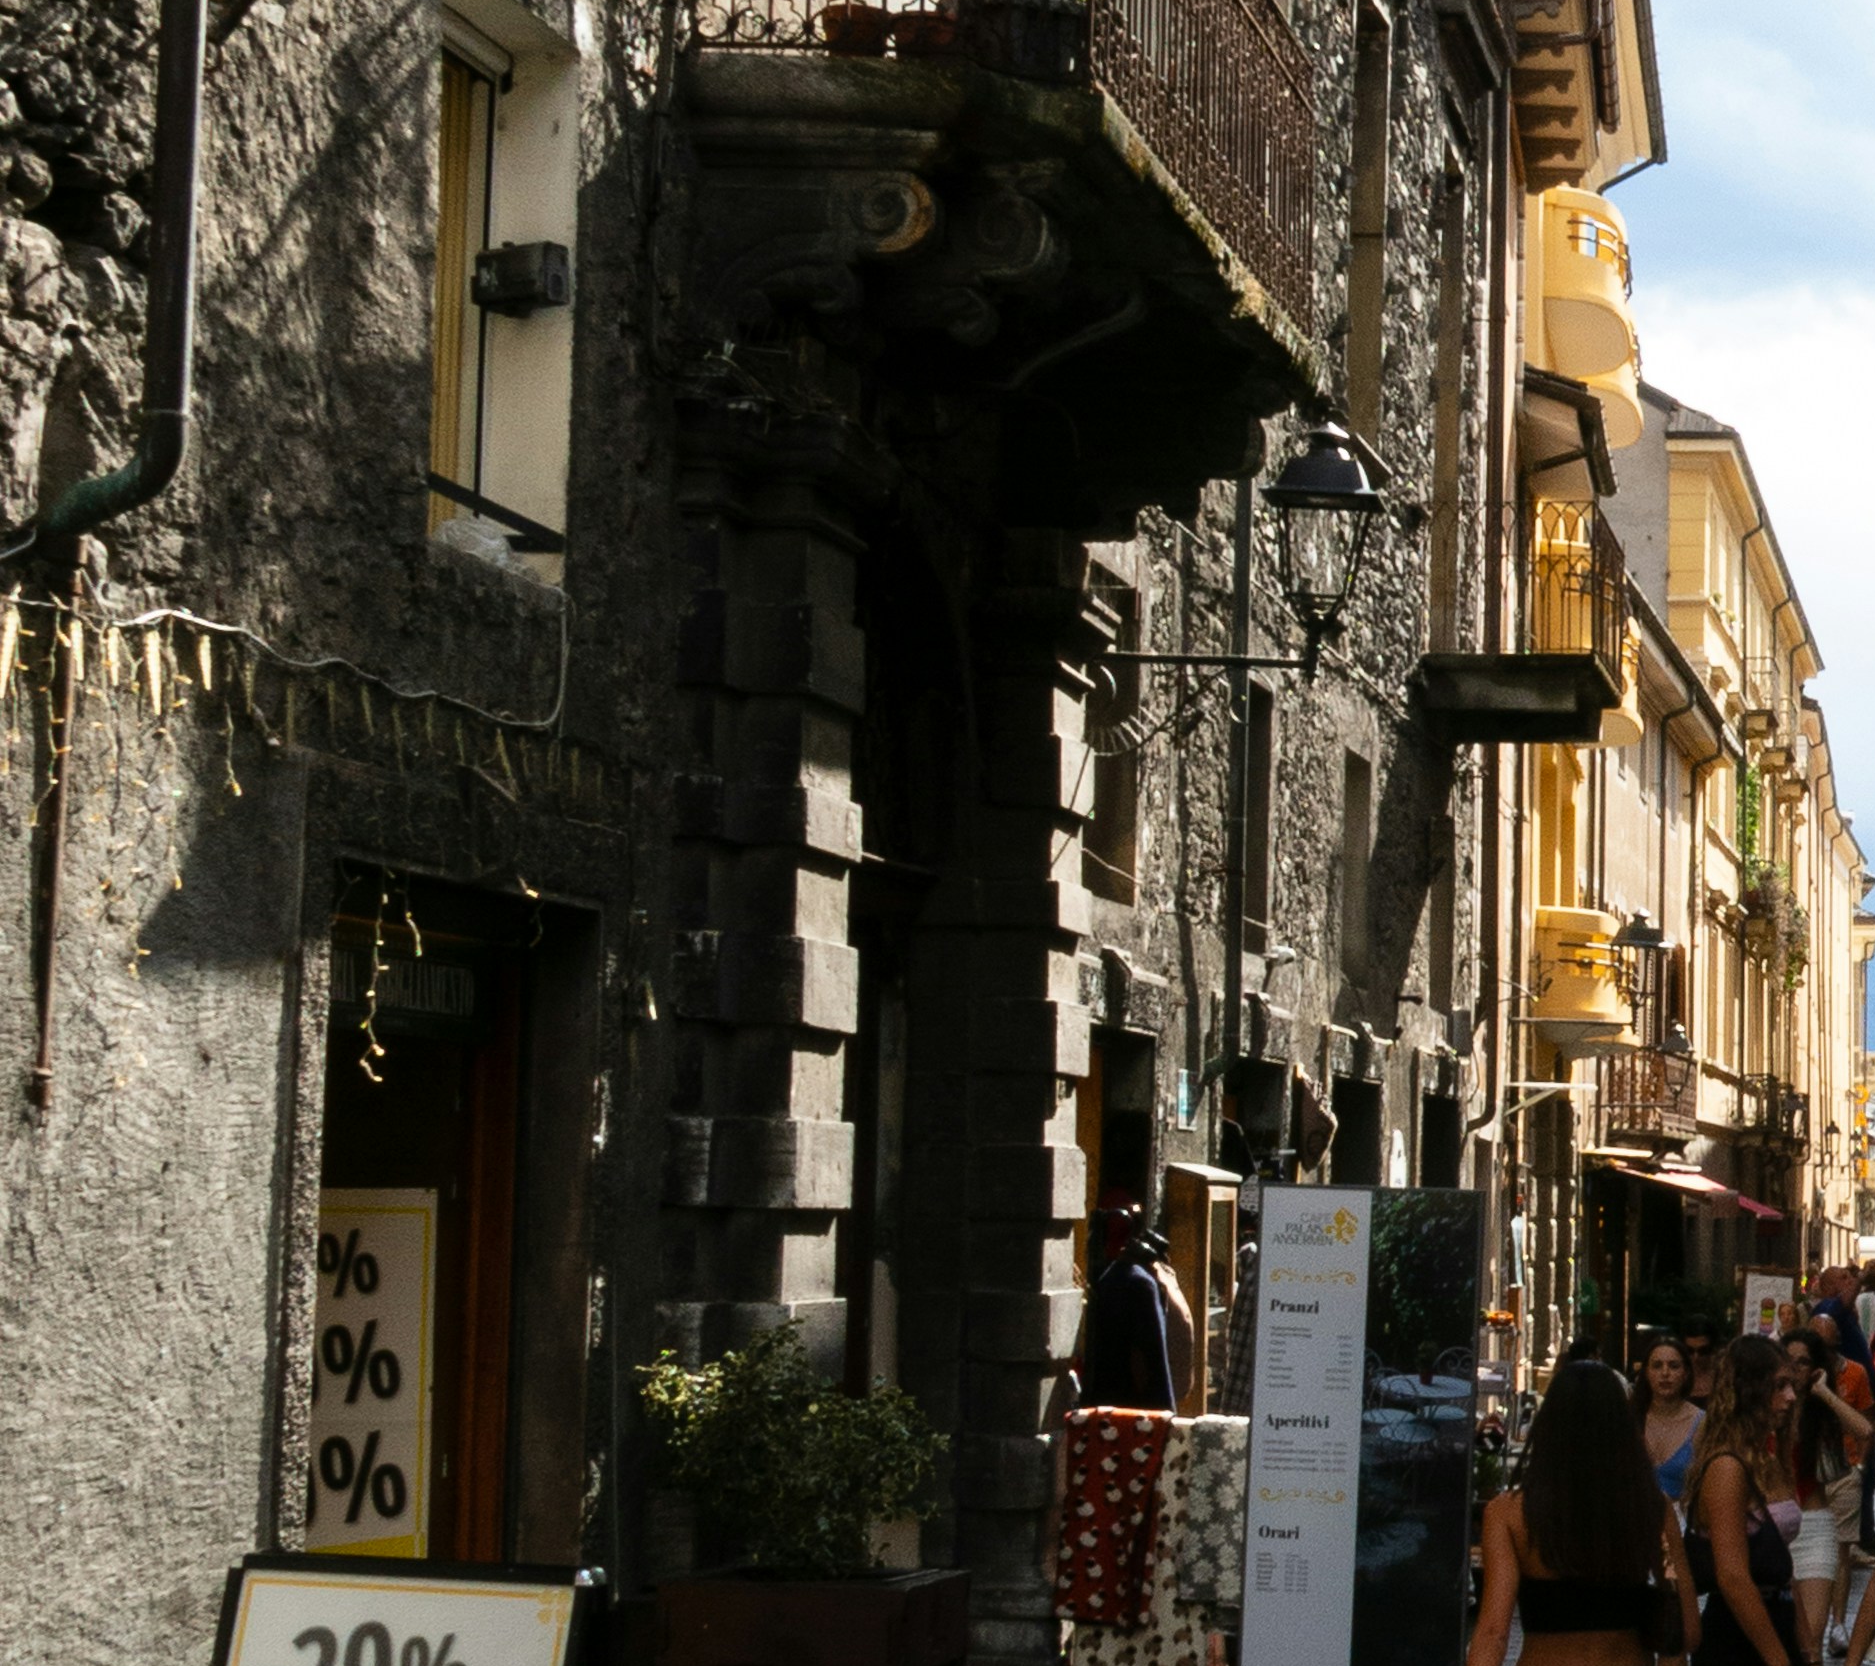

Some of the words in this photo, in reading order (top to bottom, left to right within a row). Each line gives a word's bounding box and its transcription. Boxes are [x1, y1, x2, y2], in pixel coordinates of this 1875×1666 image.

[1270, 1298, 1320, 1315] Pranzi
[1265, 1413, 1330, 1431] Aperitivi
[1258, 1524, 1300, 1540] Orari
